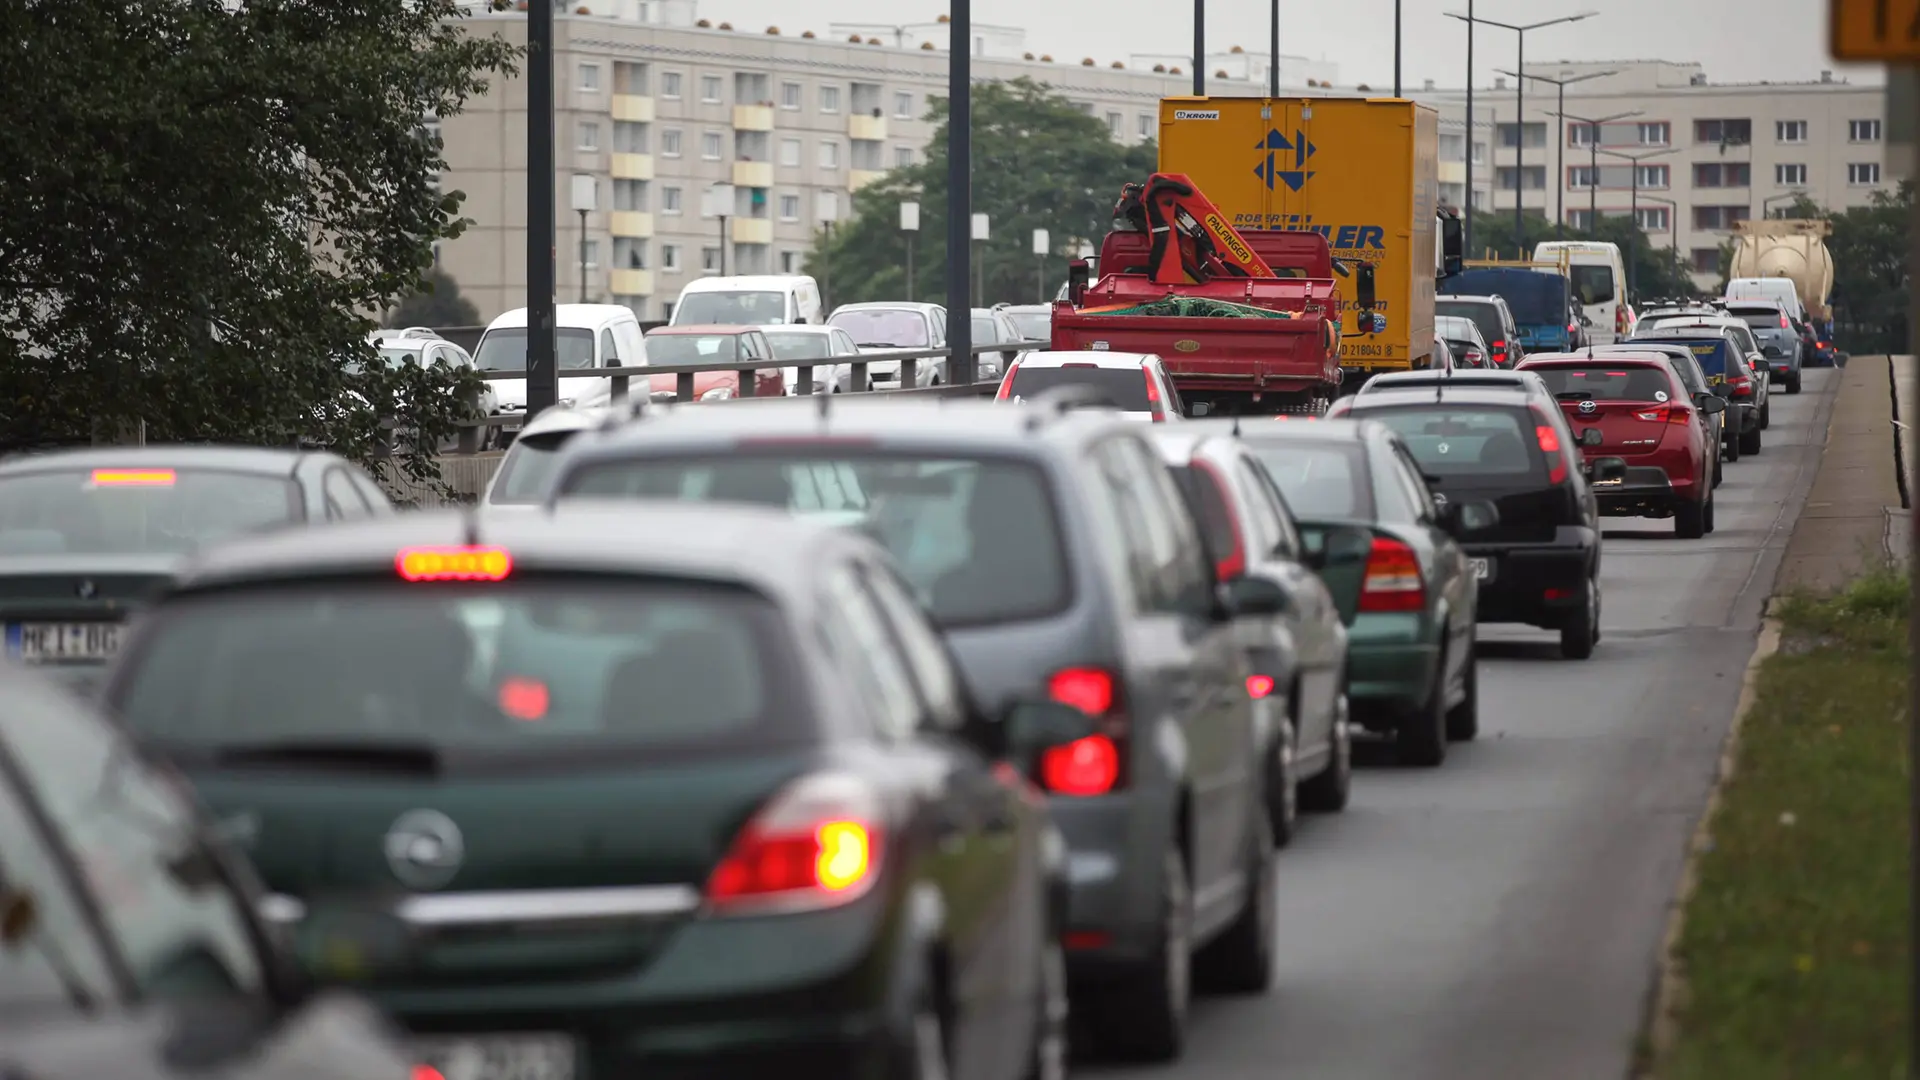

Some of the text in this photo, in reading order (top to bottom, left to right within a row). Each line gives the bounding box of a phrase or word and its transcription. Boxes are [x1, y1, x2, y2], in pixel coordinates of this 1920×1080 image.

[1234, 213, 1289, 223] ROBERT
[1207, 216, 1249, 261] PALFINGER
[1331, 250, 1385, 259] EUROPEAN
[1350, 344, 1382, 356] 218043
